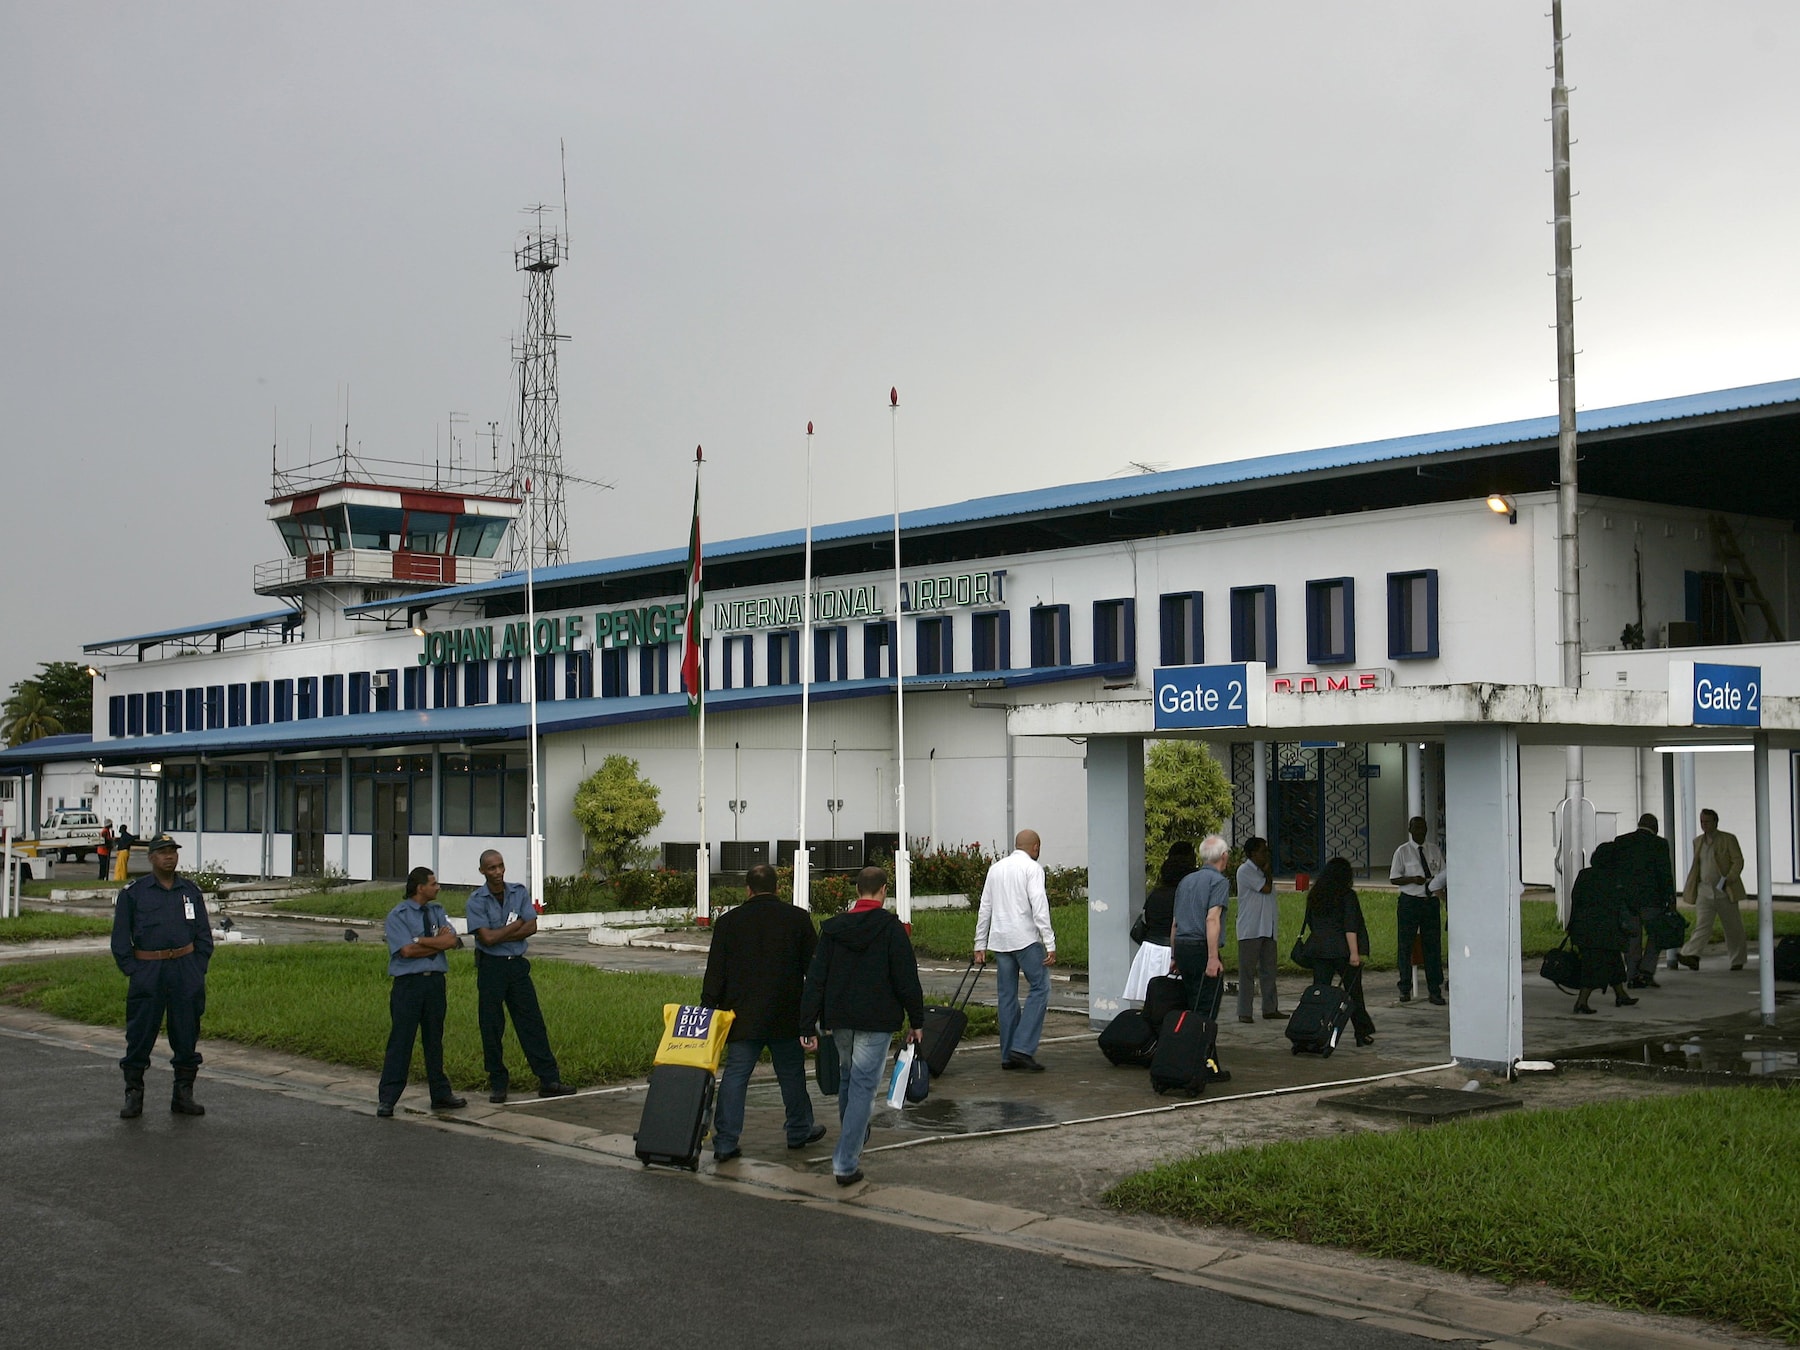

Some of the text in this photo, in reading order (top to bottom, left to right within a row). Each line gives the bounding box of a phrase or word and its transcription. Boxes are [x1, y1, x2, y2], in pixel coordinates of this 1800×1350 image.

[418, 569, 1007, 666] JOHAN ADOLF PENGE INTERNAIONAL AIRPORT
[1158, 680, 1243, 714] Gate 2
[1696, 678, 1758, 711] Gate 2
[680, 1015, 707, 1026] BUY
[683, 1006, 709, 1015] SEE
[677, 1026, 708, 1037] FLY
